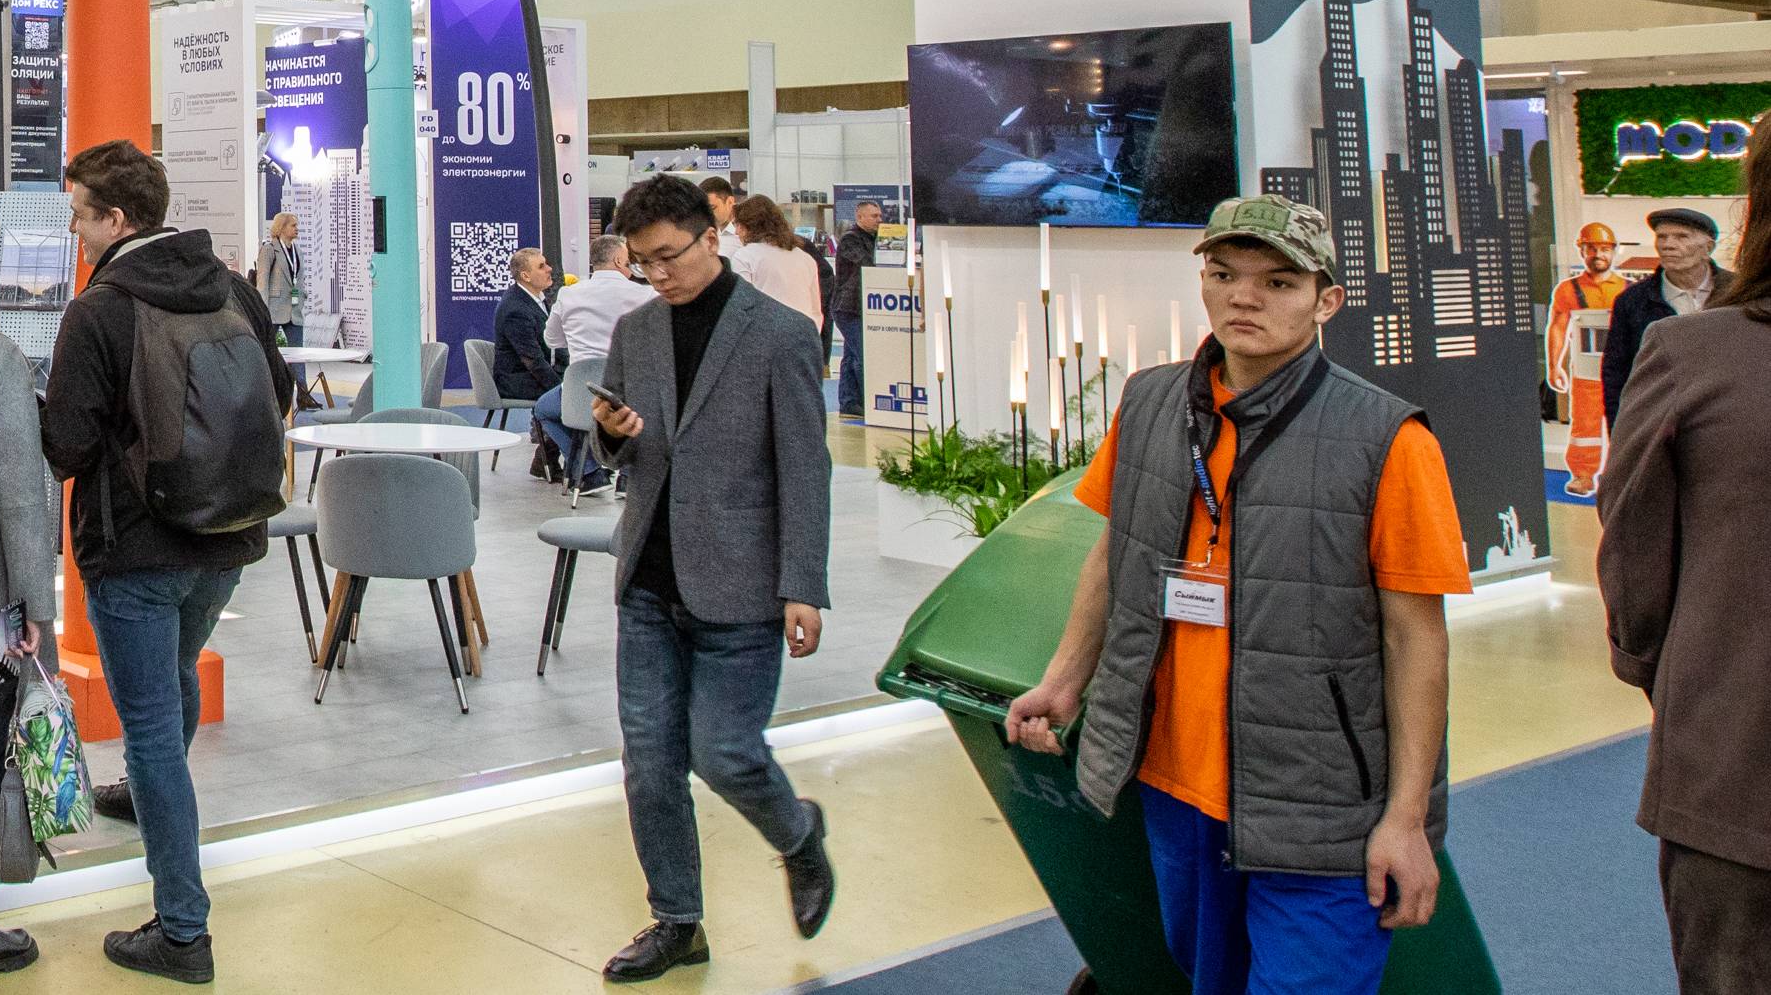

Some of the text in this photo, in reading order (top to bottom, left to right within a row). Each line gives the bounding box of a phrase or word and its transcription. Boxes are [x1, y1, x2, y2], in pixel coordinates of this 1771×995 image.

[173, 30, 229, 49] НАДЁЖНОСТЬ
[182, 45, 221, 60] В ЛЮБЫХ
[12, 55, 60, 69] ЗАЩИТЫ
[179, 58, 224, 74] УСЛОВИЯХ
[265, 54, 326, 72] НАЧИНАЕТСЯ
[265, 72, 342, 90] С ПРАВИЛЬНОГО
[419, 125, 436, 133] 040
[442, 135, 456, 145] до
[1616, 121, 1755, 159] MOD
[442, 154, 493, 165] экономии
[442, 167, 526, 179] электроэнергии
